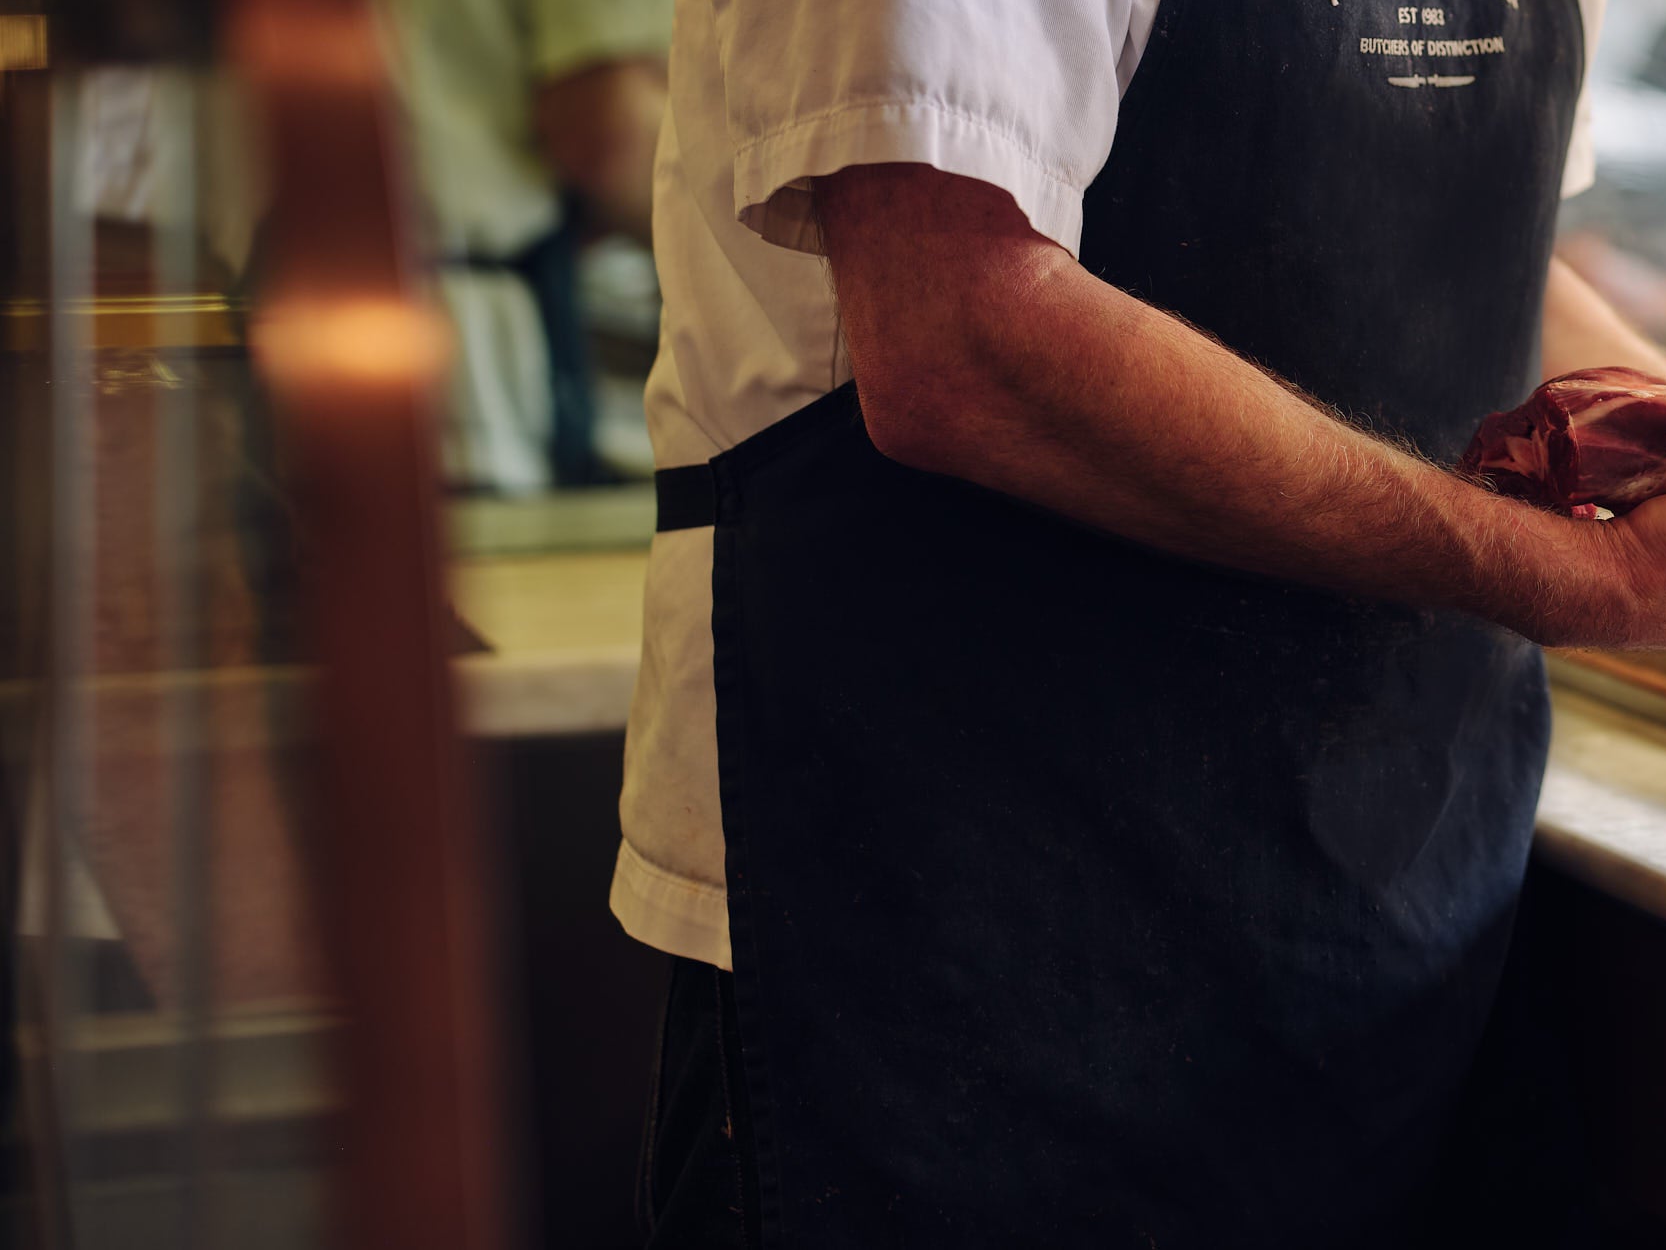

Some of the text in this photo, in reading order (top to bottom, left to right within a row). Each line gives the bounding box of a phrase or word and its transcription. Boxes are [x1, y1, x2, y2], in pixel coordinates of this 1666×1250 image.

[1398, 6, 1418, 25] EST
[1360, 36, 1505, 57] BUTCHERS OF DISTINCTION
